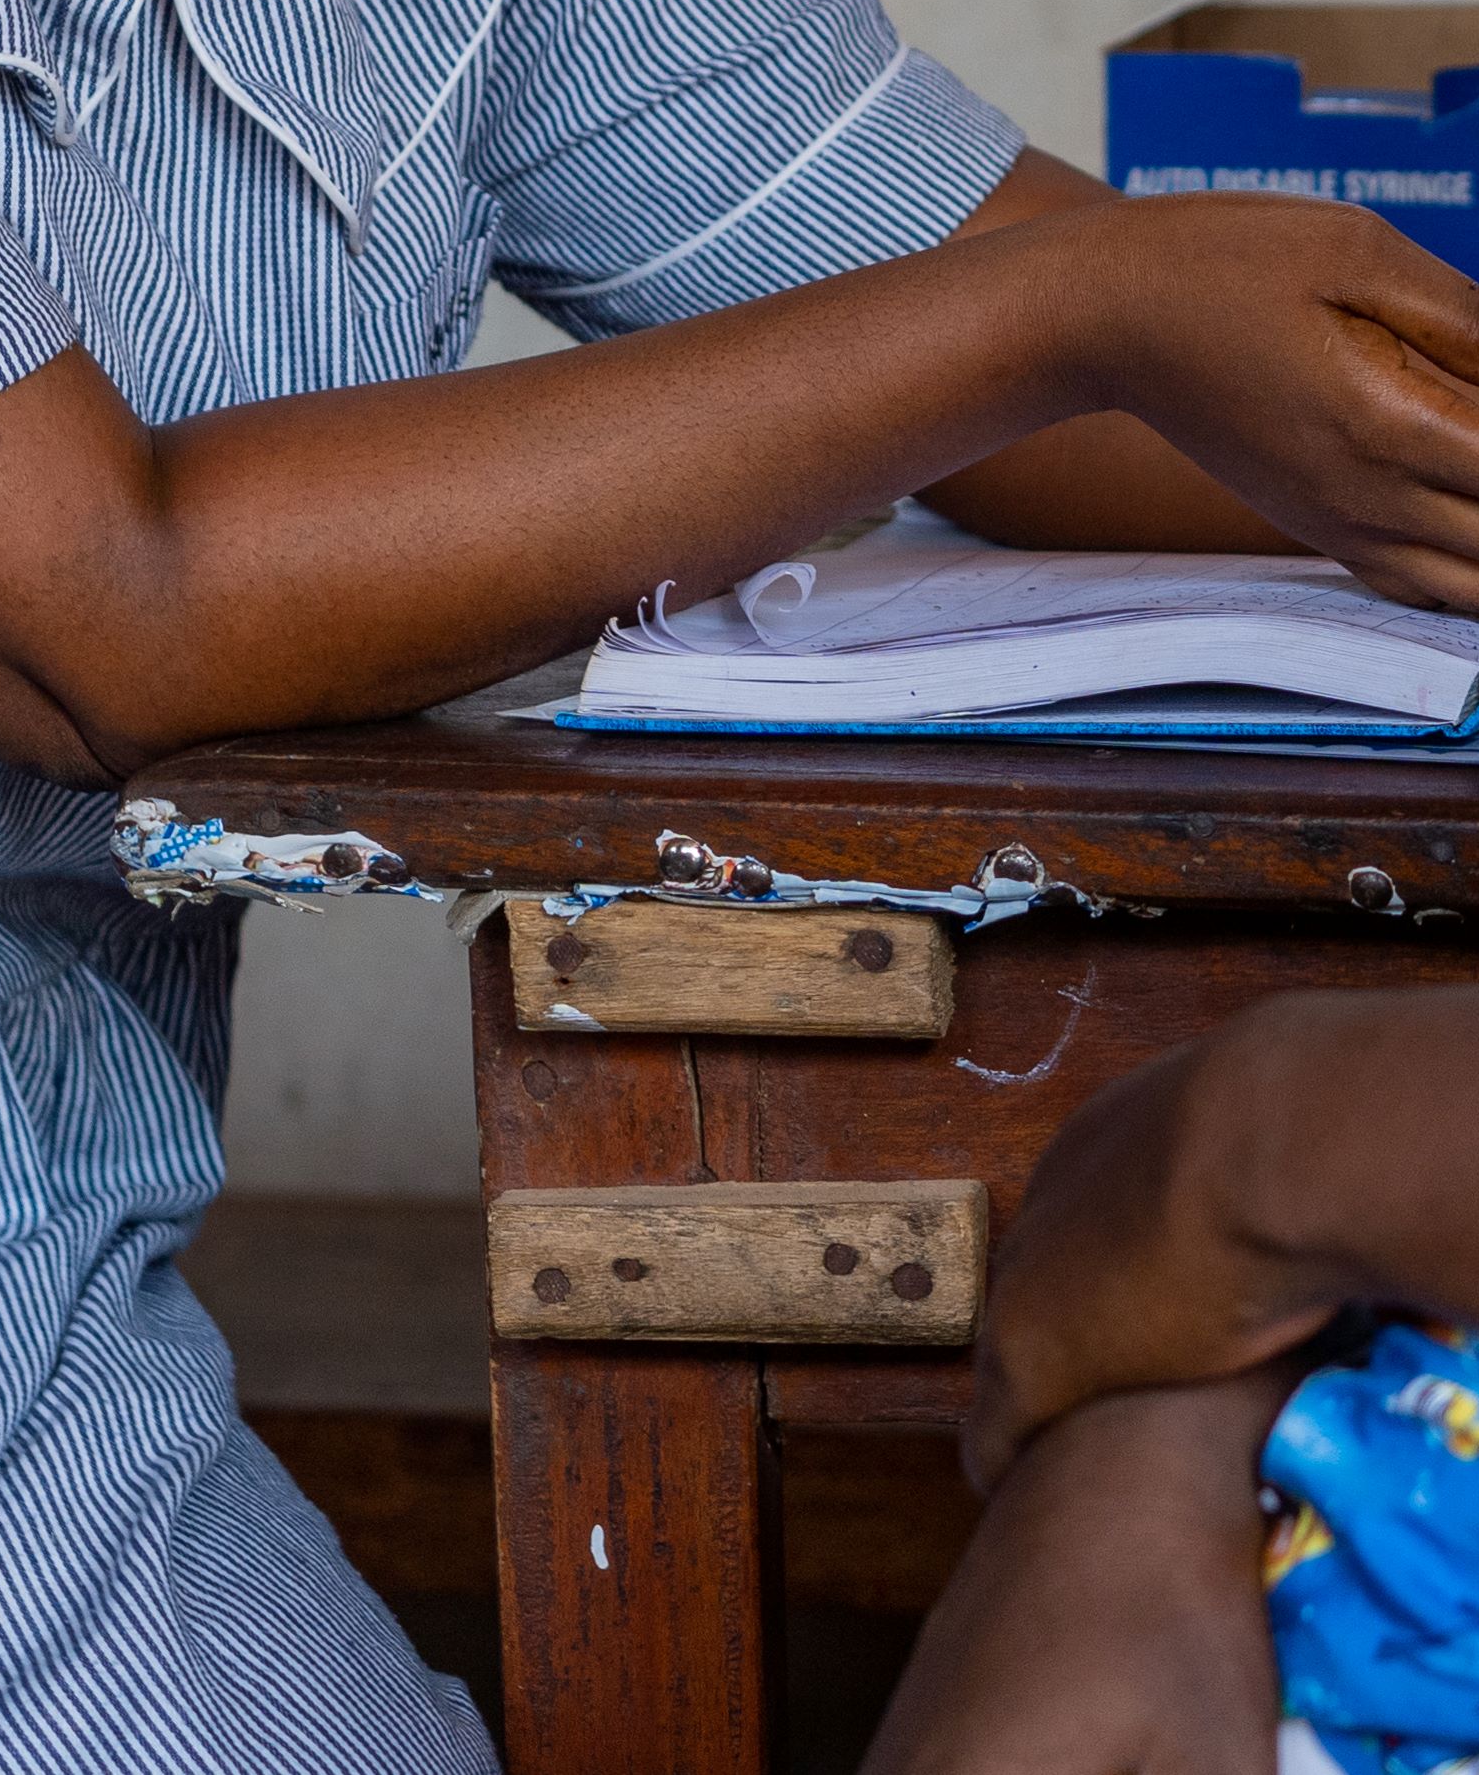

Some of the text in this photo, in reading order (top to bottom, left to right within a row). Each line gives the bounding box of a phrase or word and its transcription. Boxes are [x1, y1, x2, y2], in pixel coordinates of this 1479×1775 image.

[1123, 167, 1471, 205] AUTO DISABLE SYRINGE
